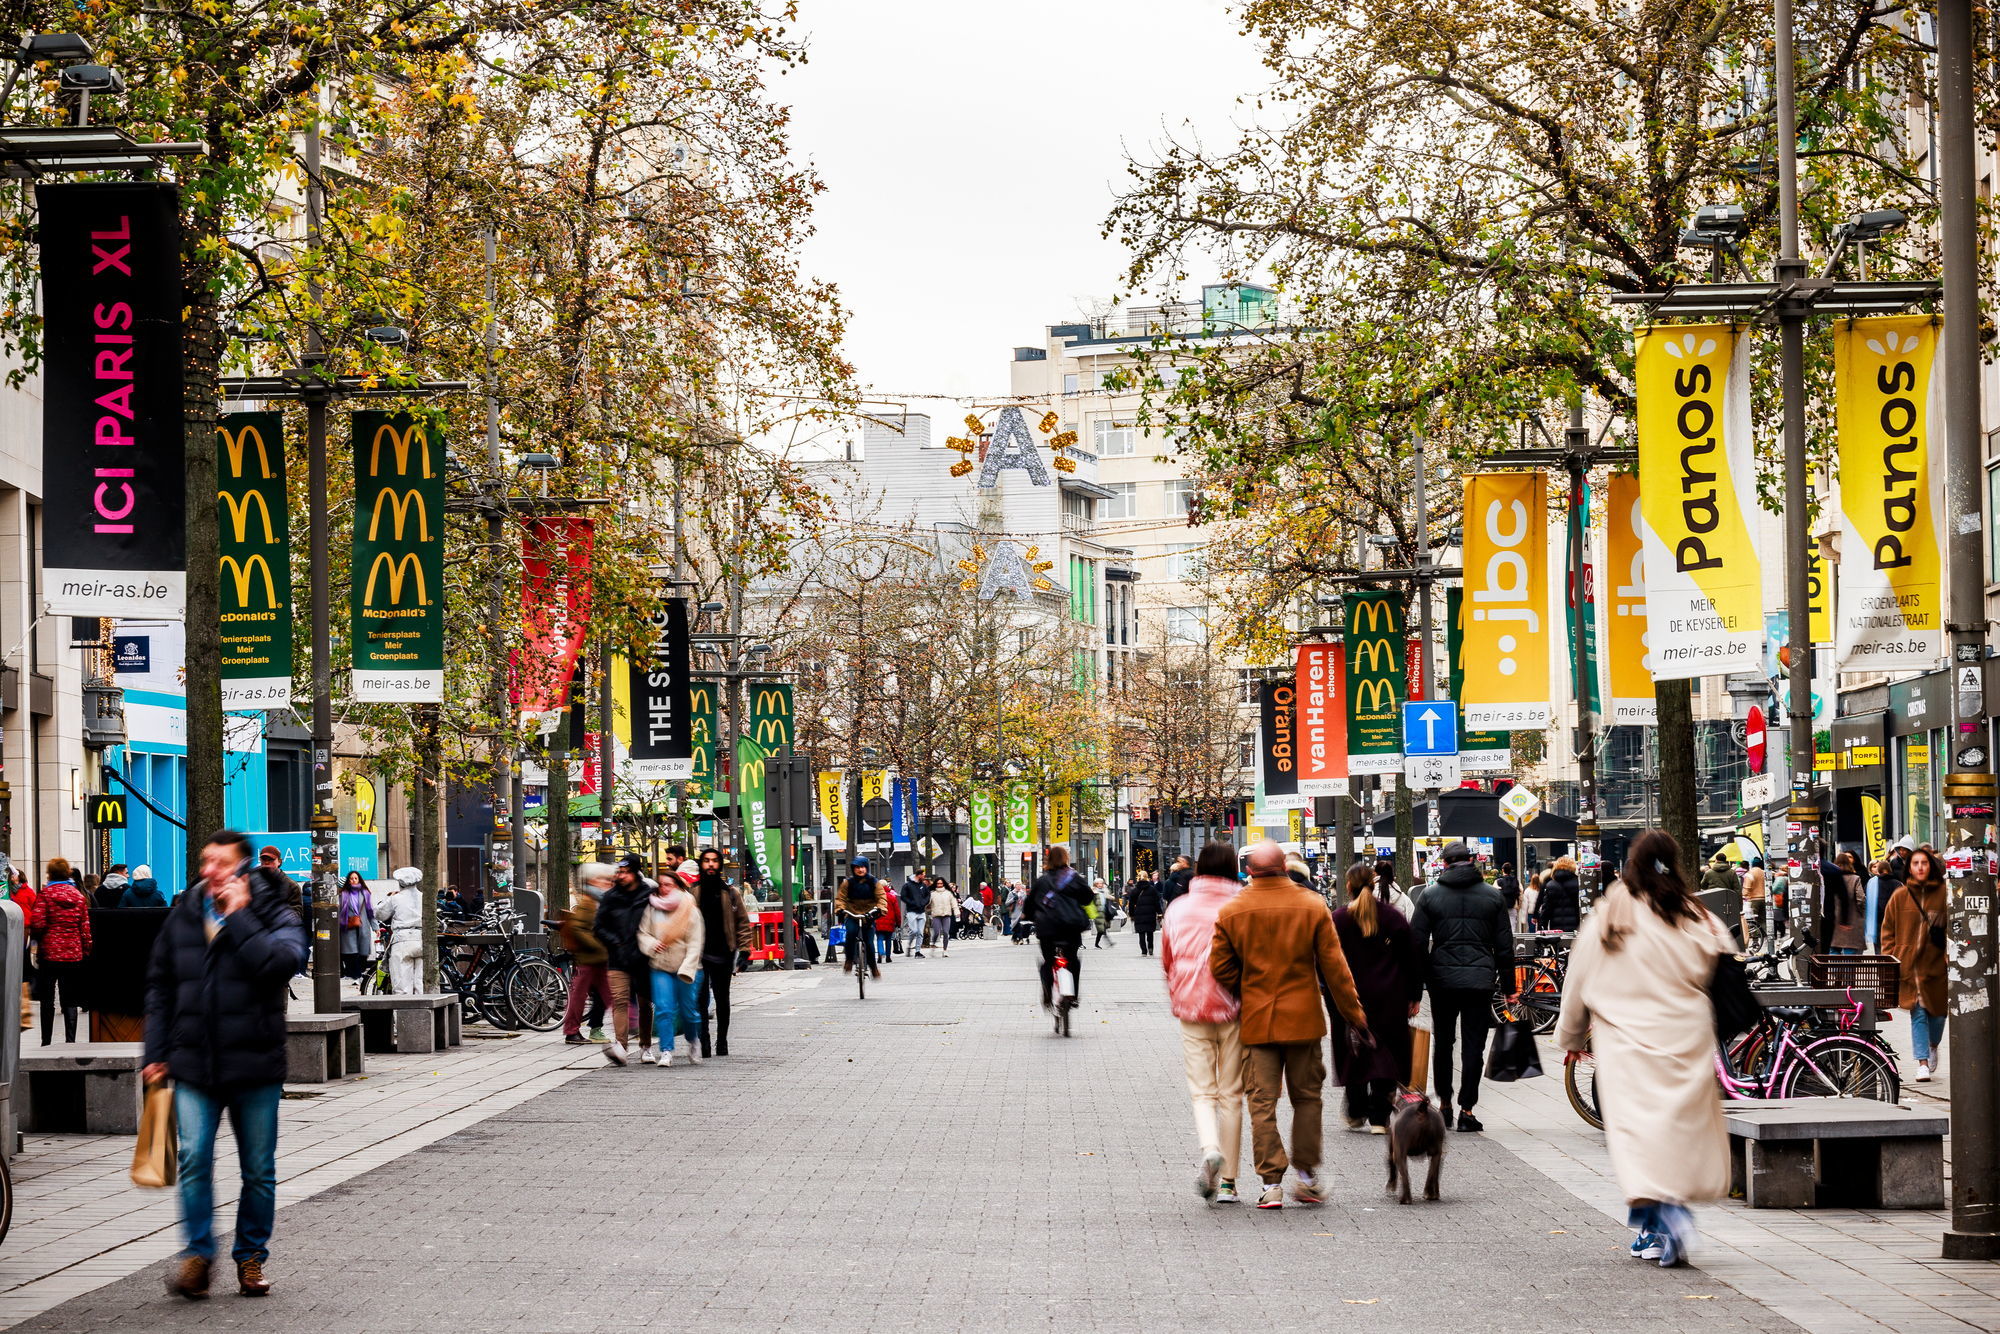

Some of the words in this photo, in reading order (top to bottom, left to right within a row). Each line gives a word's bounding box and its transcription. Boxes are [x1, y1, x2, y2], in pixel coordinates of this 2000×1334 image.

[91, 214, 132, 277] XL
[93, 300, 135, 447] PARIS
[1674, 363, 1724, 574] Panos
[1873, 360, 1918, 571] Panos
[93, 468, 135, 534] ICI
[1473, 498, 1540, 633] jbc
[61, 579, 168, 600] meir-as.be
[1690, 598, 1716, 612] MEIR
[1860, 594, 1920, 610] GROENPLAATS
[220, 611, 277, 623] cDonald's
[362, 608, 427, 619] McDonald's
[1849, 613, 1930, 630] NATIONALESTRAAT
[1670, 619, 1683, 633] DE
[1686, 615, 1738, 632] KEYSERLEI
[367, 630, 421, 641] Teniersplaats
[236, 645, 254, 654] Meir
[384, 641, 403, 650] Meir
[1663, 641, 1748, 661] meir-as.be
[1850, 638, 1927, 657] meir-as.be
[221, 655, 270, 666] Groenplaats
[369, 651, 419, 662] Groenplaats
[1327, 651, 1336, 699] schoenen
[1412, 646, 1421, 694] schoenen
[362, 677, 431, 690] meir-as.be
[220, 687, 287, 700] eir-as.be
[1307, 651, 1326, 773] vanHaren
[1355, 713, 1397, 721] McDonald's
[1470, 710, 1545, 722] meir-as.be
[1617, 705, 1659, 717] meir-a
[649, 696, 672, 746] THE
[1272, 686, 1294, 773] Orange
[1355, 757, 1401, 767] meir-as.be
[1460, 754, 1504, 764] meir-as.be
[640, 762, 685, 773] meir-as.be
[1304, 781, 1343, 790] meir-as.be
[828, 785, 840, 834] Panos
[1267, 797, 1307, 806] meir-as.be
[1056, 800, 1064, 838] TORFS
